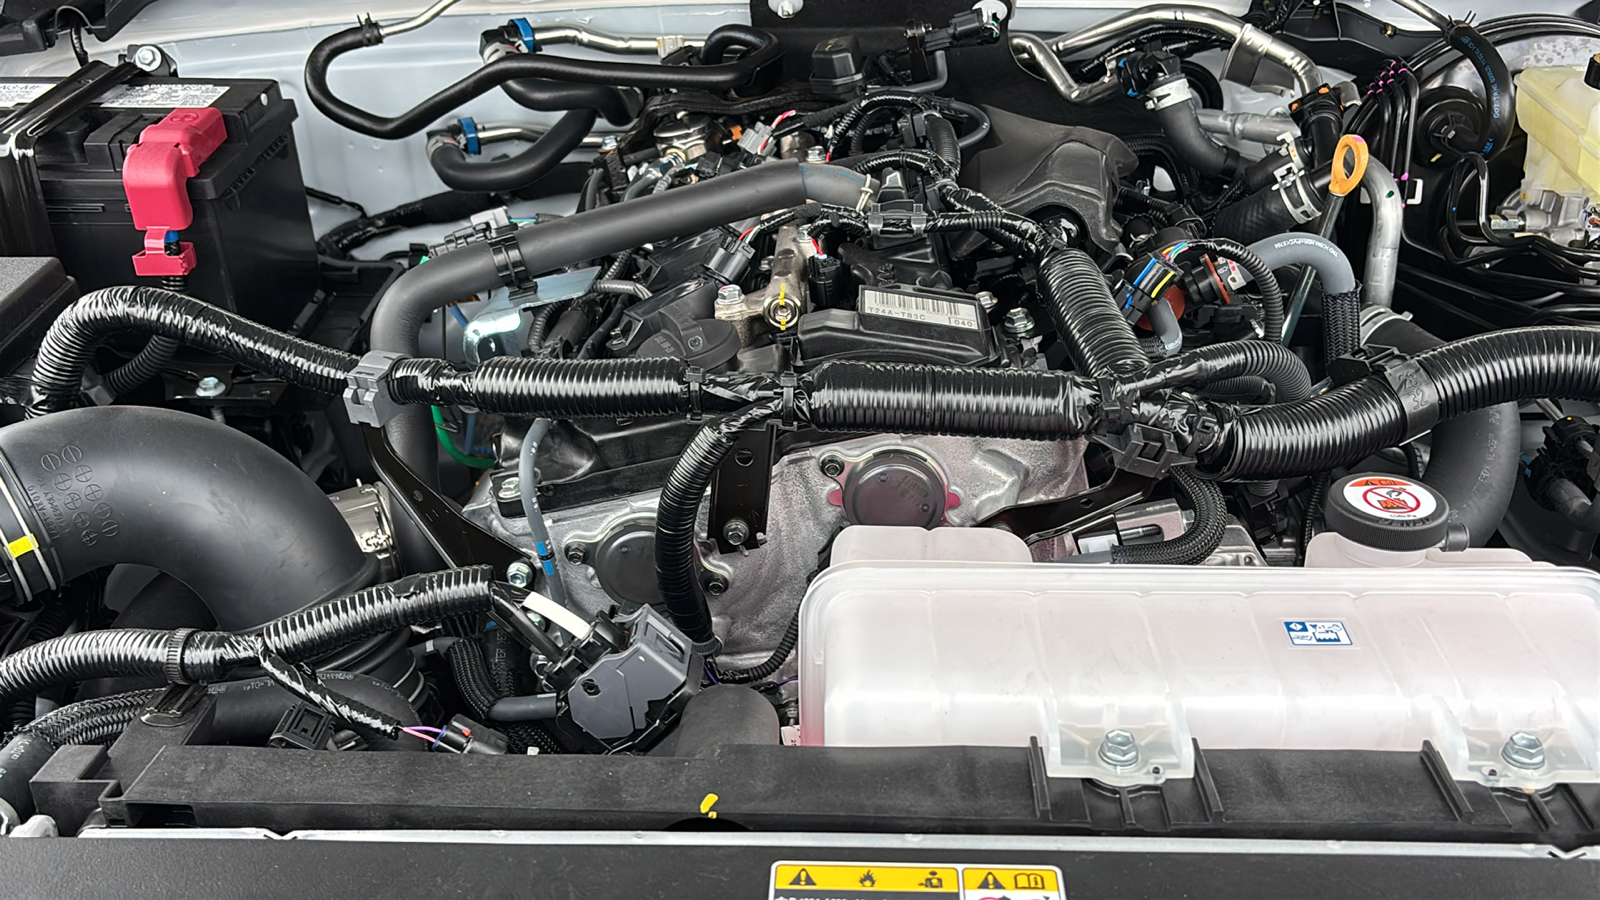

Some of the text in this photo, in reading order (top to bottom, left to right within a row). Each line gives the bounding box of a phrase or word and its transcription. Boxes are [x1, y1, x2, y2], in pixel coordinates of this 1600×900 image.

[868, 306, 926, 321] T24A-T83C
[953, 319, 973, 328] 040
[1406, 387, 1429, 411] 32
